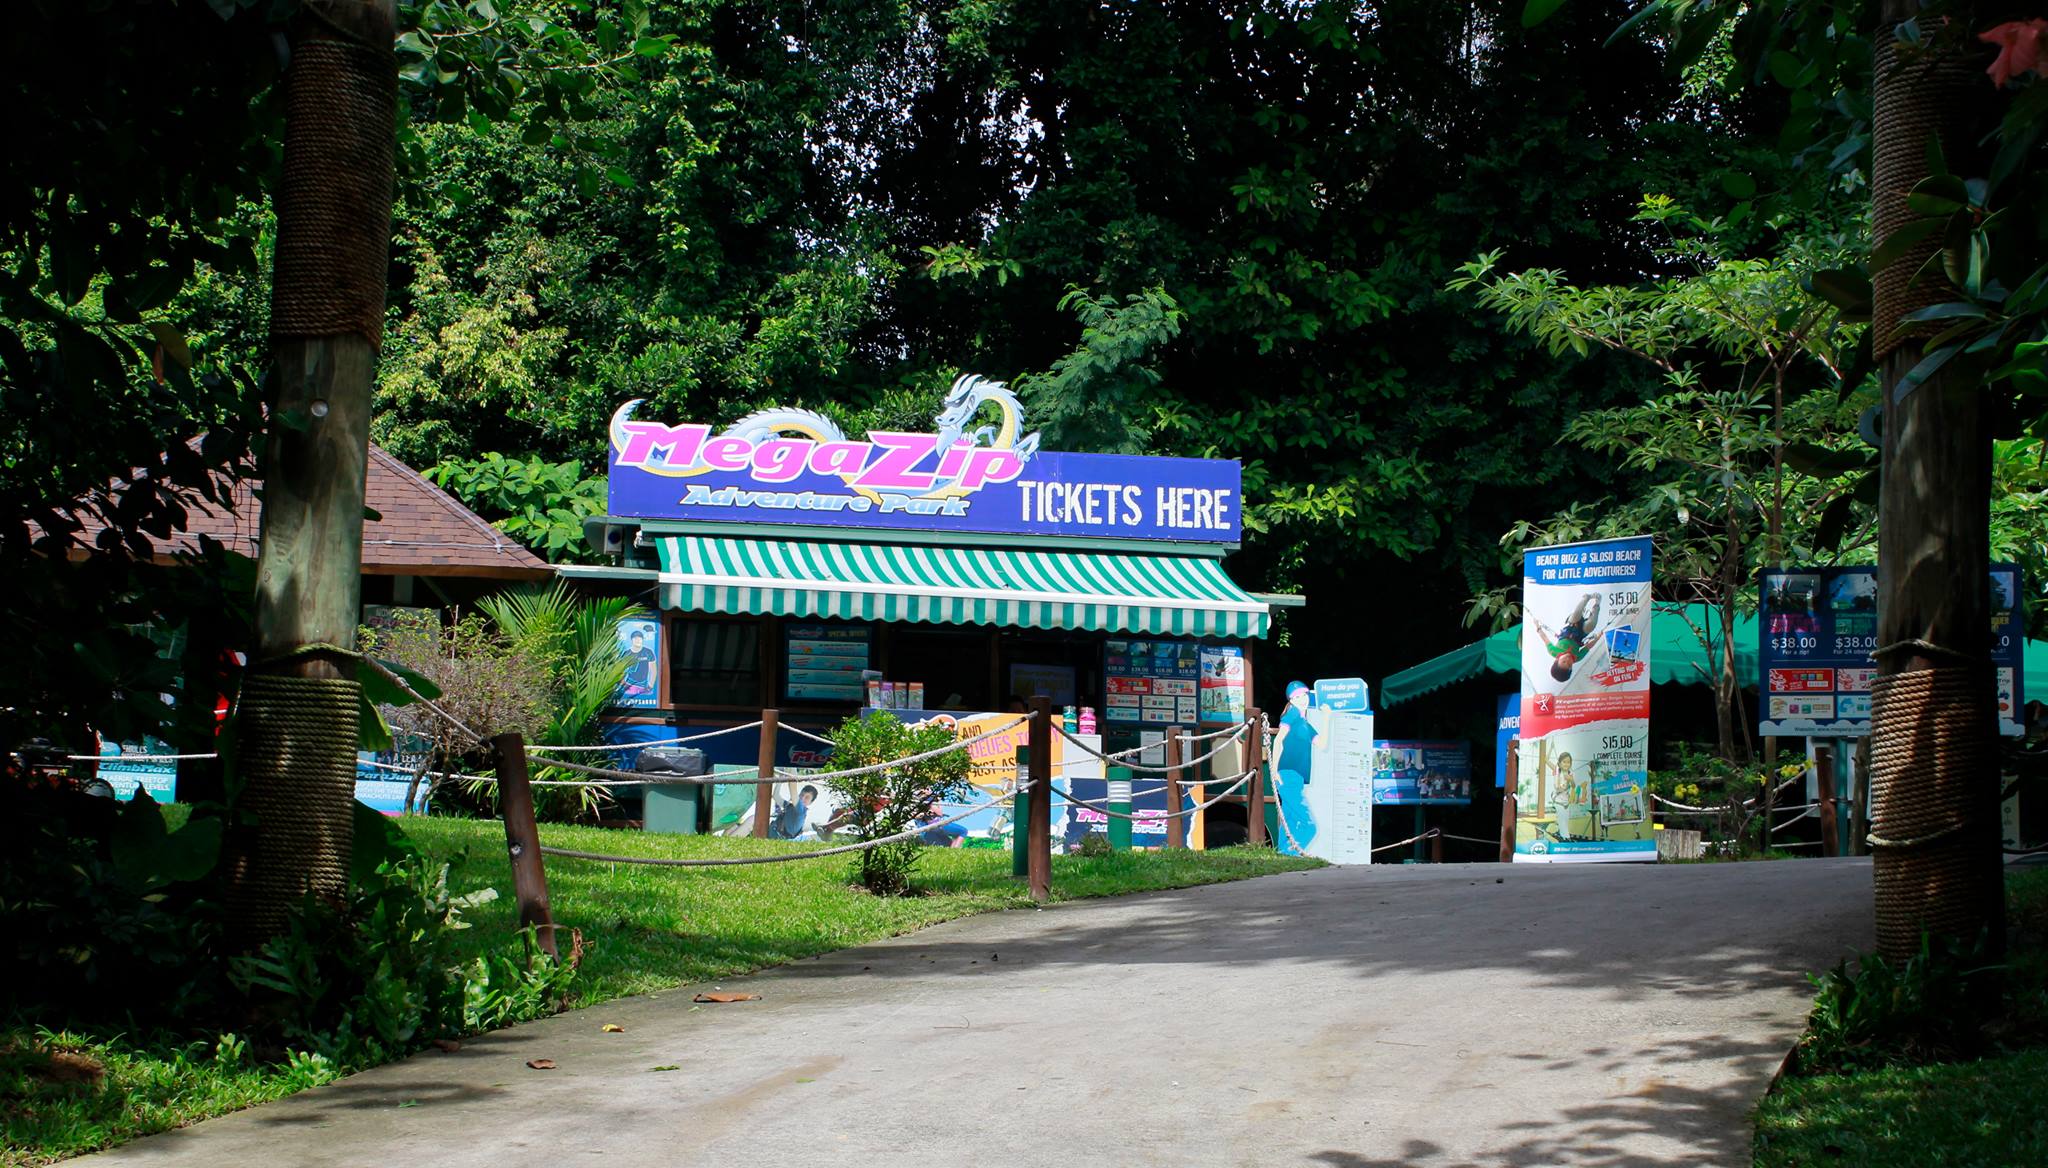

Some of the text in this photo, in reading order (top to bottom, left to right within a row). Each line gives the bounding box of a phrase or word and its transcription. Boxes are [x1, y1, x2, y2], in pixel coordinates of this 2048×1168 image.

[614, 420, 1024, 491] MegaZip
[679, 484, 971, 517] Adventure Park
[1017, 481, 1231, 530] TICKETS HERE
[1536, 555, 1559, 566] BEACH
[1561, 553, 1578, 565] BUZZ
[1589, 551, 1613, 563] SILOSO
[1616, 550, 1641, 562] BEACH!
[1543, 564, 1636, 580] FOR LITTLE ADVENTURERS!
[1609, 591, 1639, 607] $15.00
[1771, 637, 1817, 650] $38.00
[1499, 716, 1520, 730] ADVEN
[962, 724, 982, 741] AND
[967, 735, 1012, 759] UEUES
[1602, 735, 1633, 750] $15.00
[1002, 757, 1017, 773] AS
